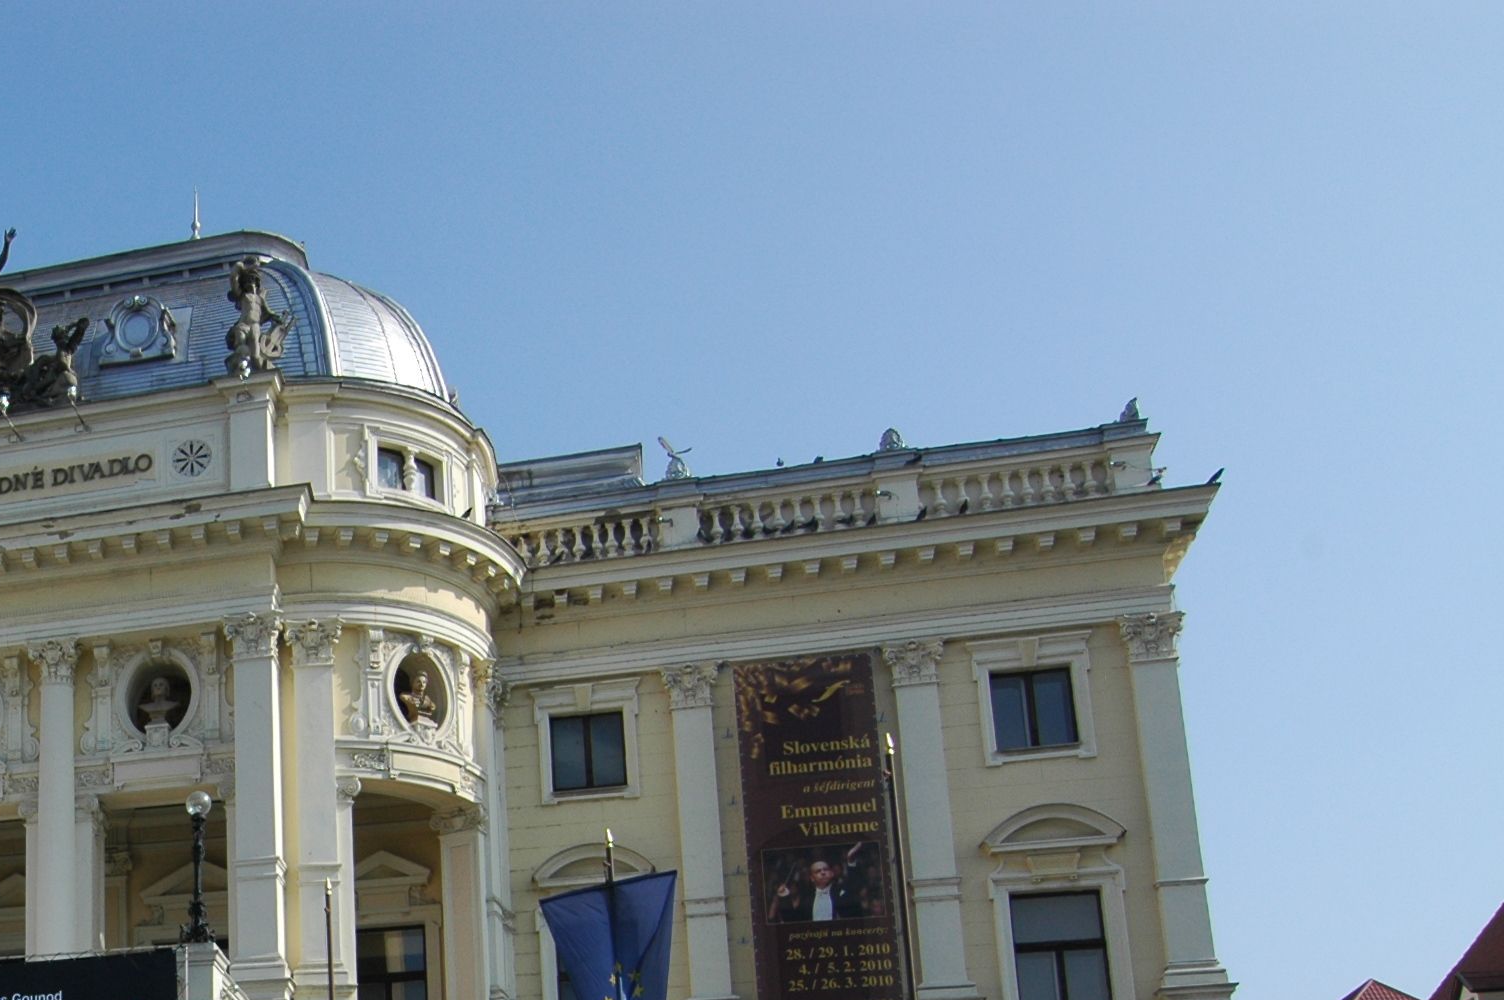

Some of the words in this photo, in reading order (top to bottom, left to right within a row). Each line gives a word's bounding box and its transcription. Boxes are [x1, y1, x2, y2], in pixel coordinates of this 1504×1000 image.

[52, 453, 153, 487] DIVADLO
[782, 733, 871, 755] Slovenská
[768, 754, 873, 775] filharmónia
[802, 785, 810, 793] a
[813, 779, 876, 793] šéfdirigent
[780, 798, 877, 819] Emmanuel
[799, 820, 879, 837] Villaume
[785, 948, 806, 961] 28.
[818, 946, 838, 958] 29.
[844, 945, 854, 957] 1.
[858, 943, 891, 956] 2010
[799, 964, 811, 975] 4.
[827, 962, 840, 974] 5.
[843, 961, 855, 973] 2.
[860, 959, 892, 972] 2010
[788, 980, 808, 992] 25.
[821, 978, 841, 990] 26.
[845, 977, 857, 988] 3.
[861, 975, 894, 988] 2010
